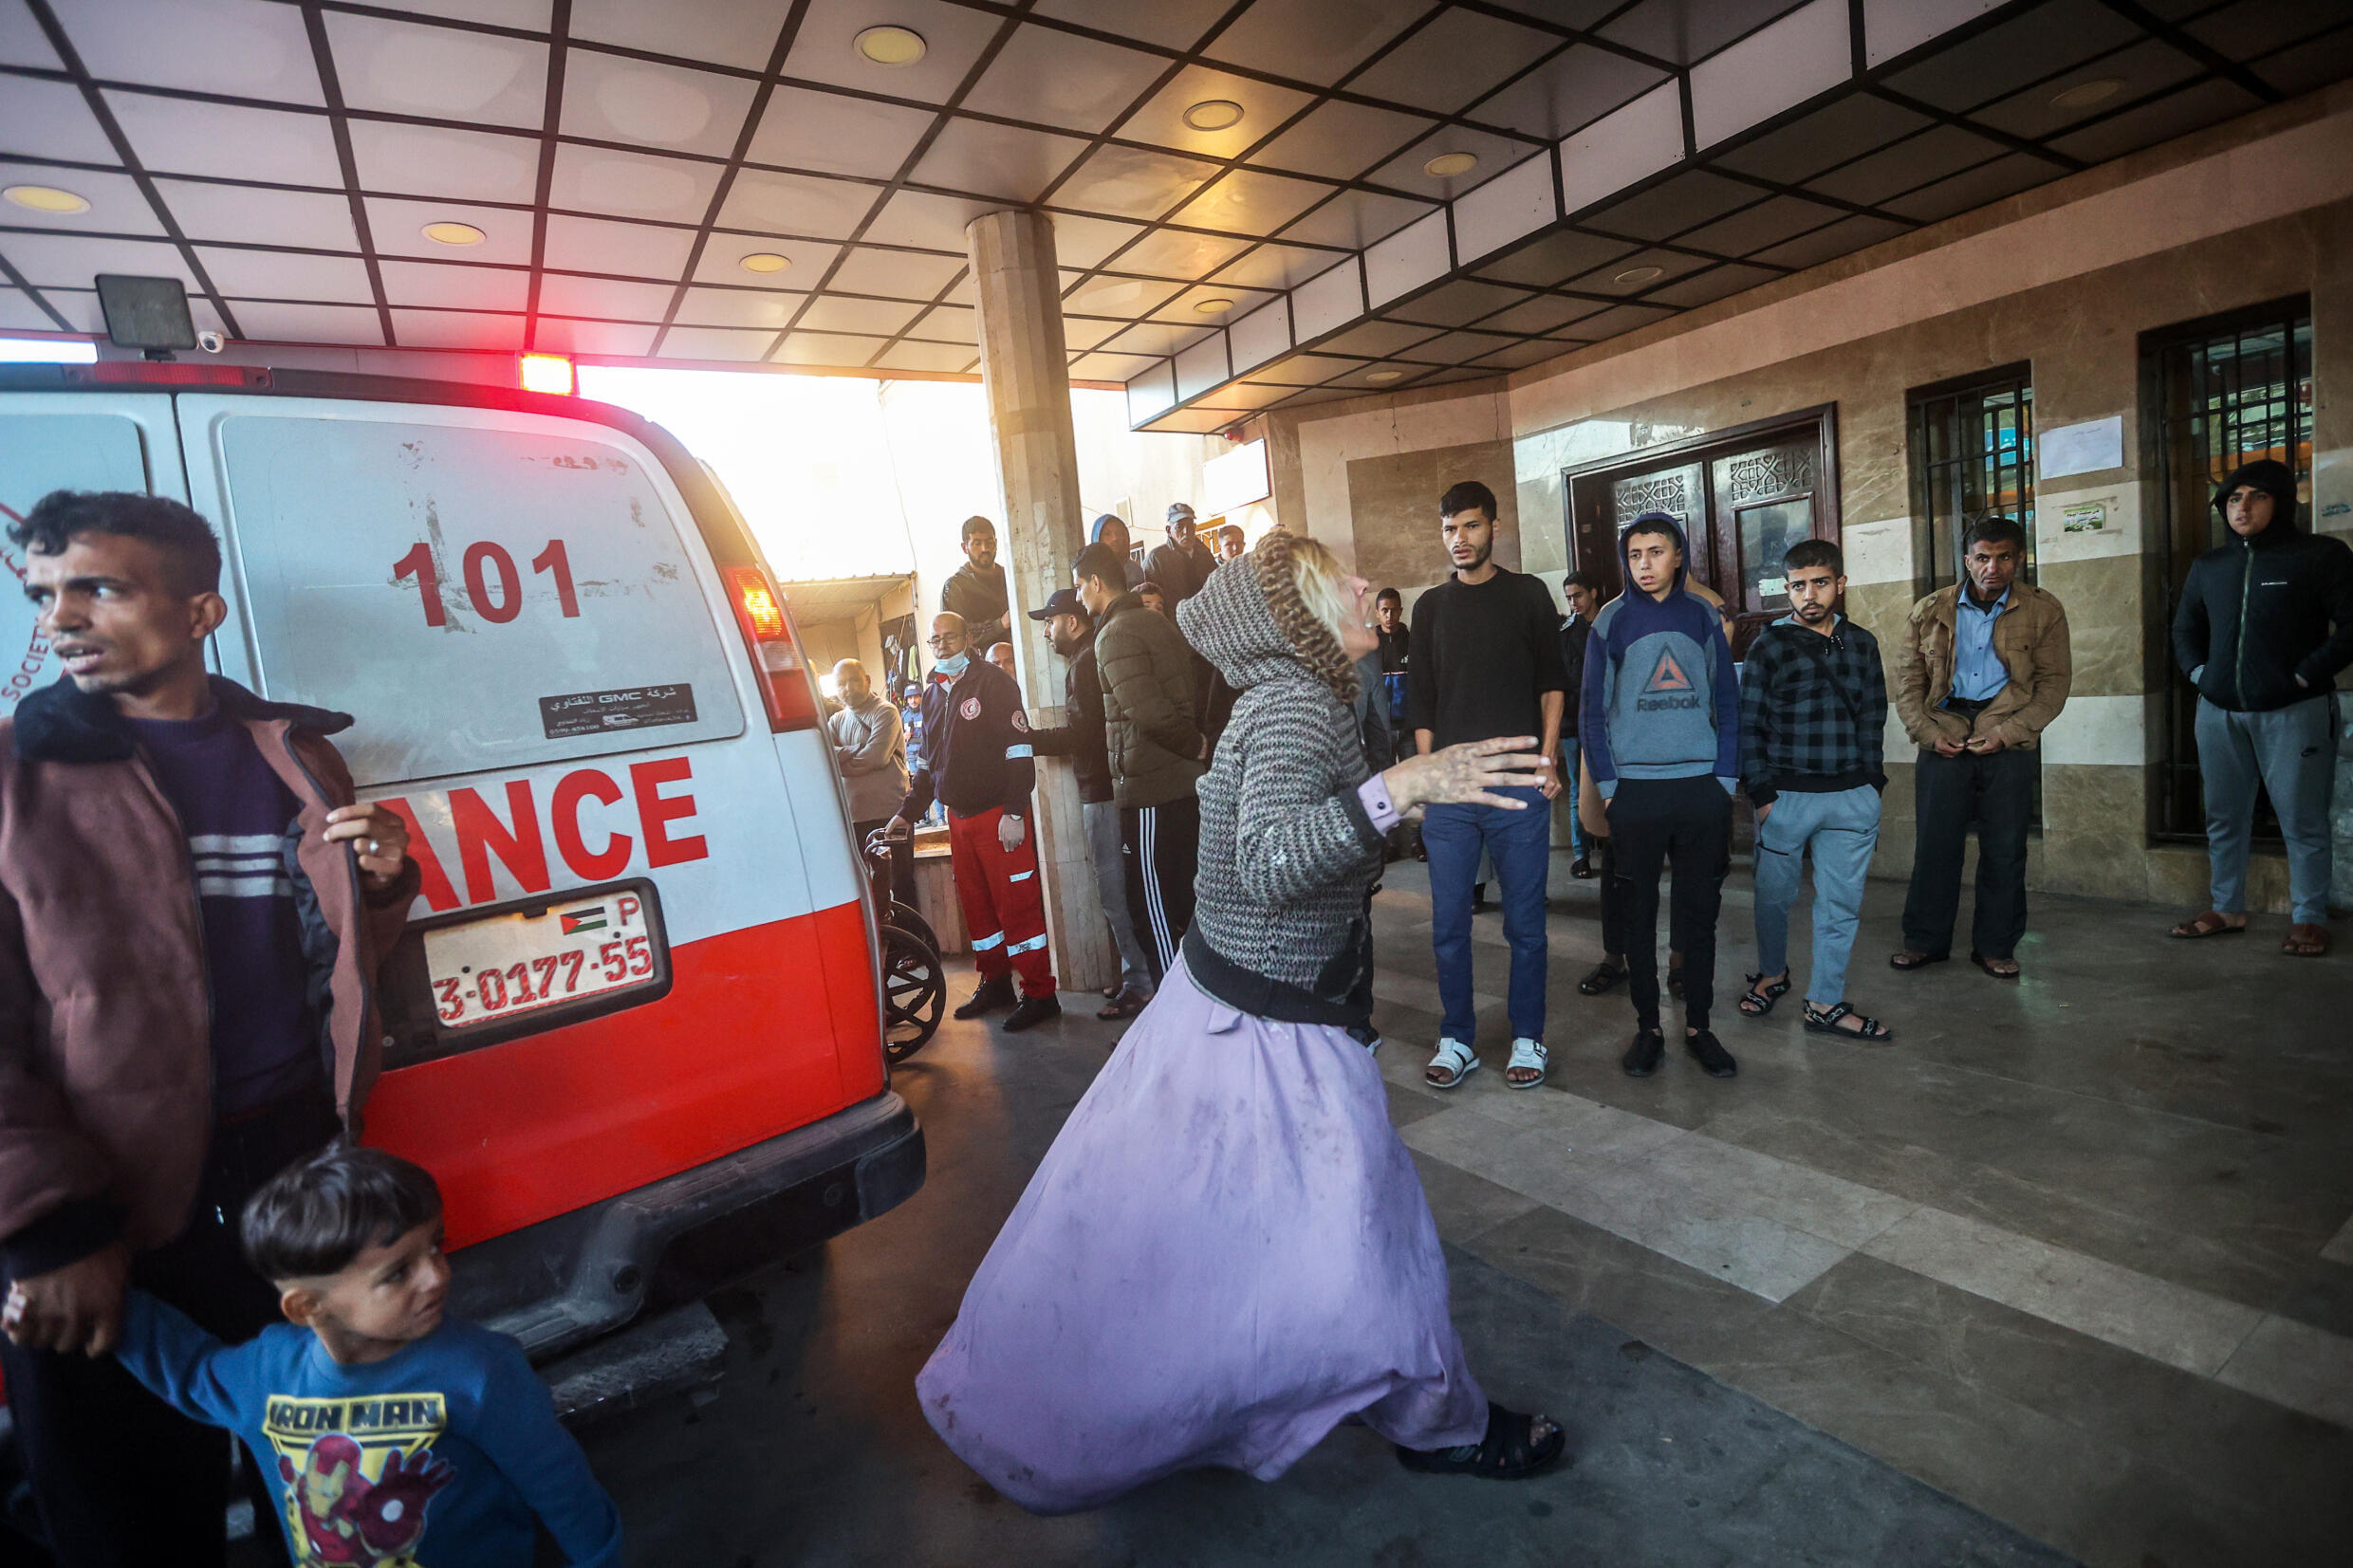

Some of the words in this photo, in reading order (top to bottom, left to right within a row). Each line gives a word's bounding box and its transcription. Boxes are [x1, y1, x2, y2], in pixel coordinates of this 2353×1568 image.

[393, 539, 581, 627] 101
[1, 618, 49, 702] SOCIET
[599, 692, 642, 704] GMC
[1637, 694, 1701, 712] Reebok
[618, 896, 640, 926] P
[269, 1401, 343, 1430] IRON
[350, 1398, 439, 1428] MAN
